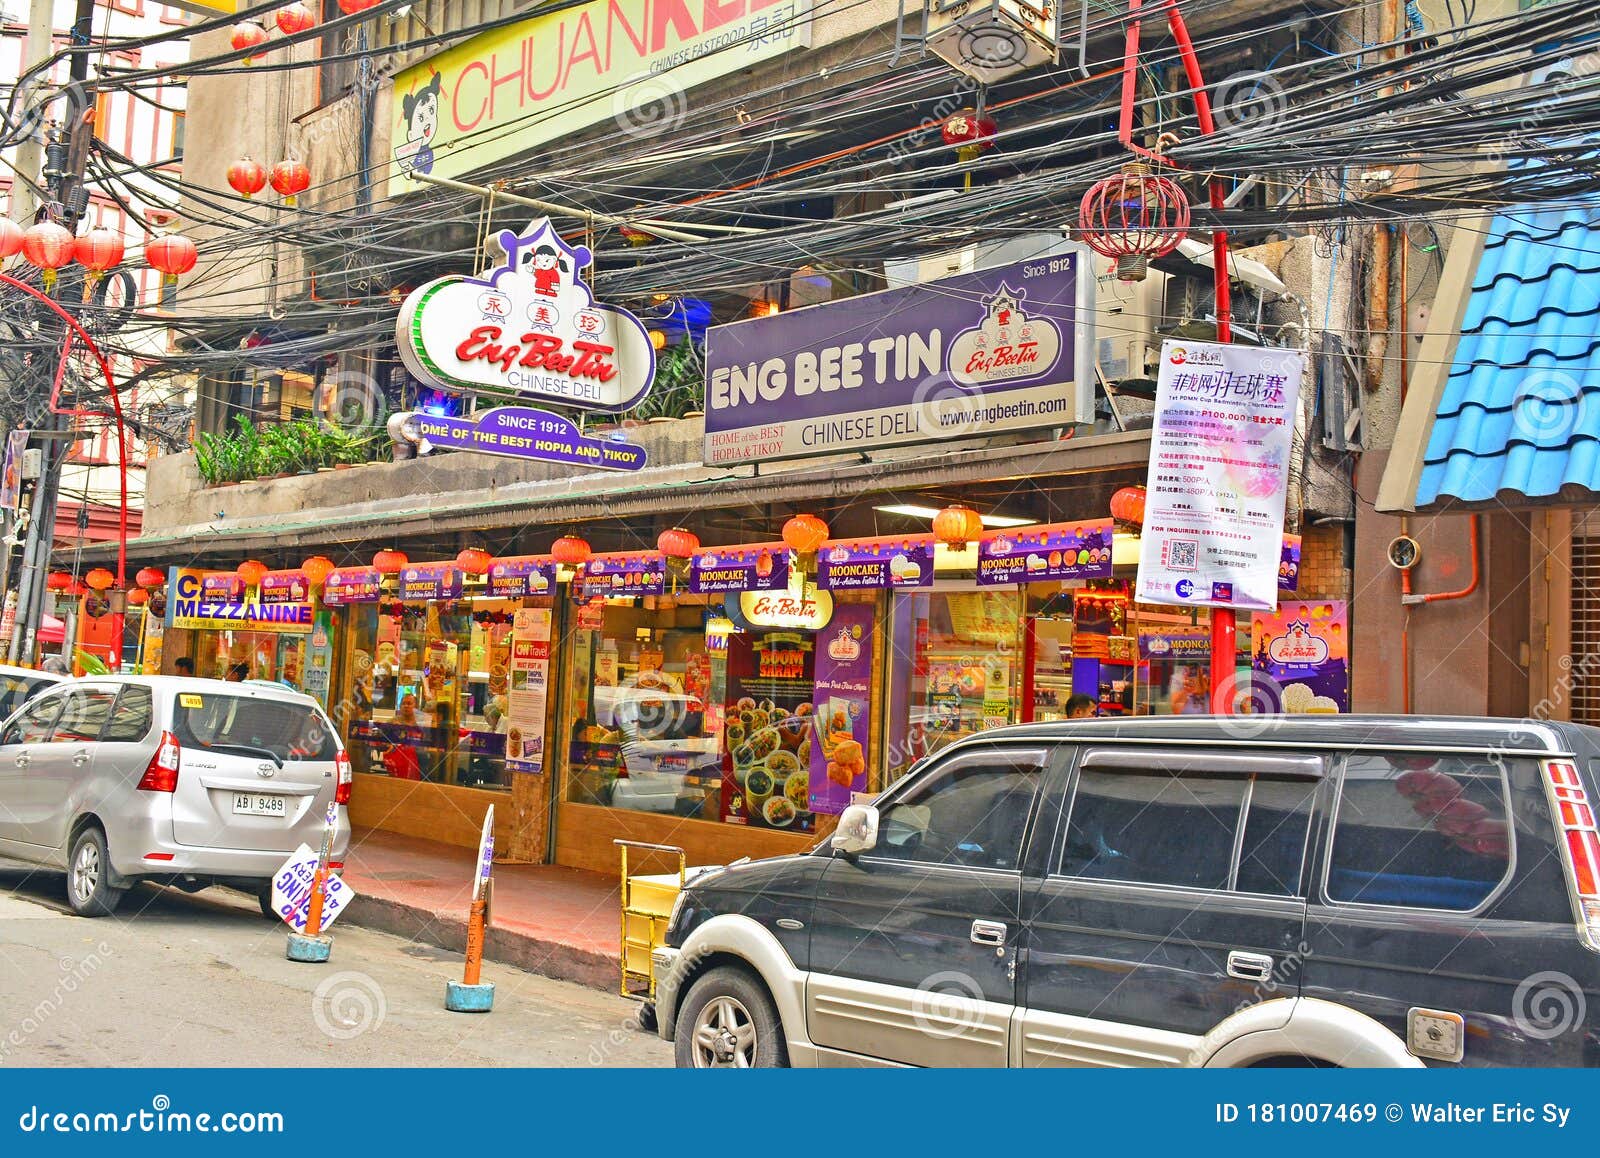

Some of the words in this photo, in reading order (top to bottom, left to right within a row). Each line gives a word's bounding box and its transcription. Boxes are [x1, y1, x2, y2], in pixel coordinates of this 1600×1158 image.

[650, 51, 690, 74] CHINESE
[692, 26, 746, 58] FASTFOOD
[1023, 264, 1047, 279] Since
[1048, 258, 1071, 274] 1912
[710, 356, 788, 410] ENG
[794, 340, 864, 397] BEE
[868, 328, 942, 385] TIN
[507, 371, 569, 395] CHINESE
[573, 381, 601, 400] DELI
[939, 396, 1067, 428] www.engbeetin.com
[497, 414, 537, 431] SINCE
[539, 418, 568, 435] 1912
[801, 416, 876, 448] CHINESE
[880, 410, 920, 438] DELI
[421, 420, 449, 438] OME
[452, 428, 470, 441] OF
[472, 430, 498, 445] THE
[500, 434, 533, 450] BEST
[535, 439, 573, 455] HOPIA
[575, 443, 600, 459] AND
[602, 447, 639, 463] TIKOY
[712, 432, 741, 447] HOME
[759, 425, 786, 439] BEST
[711, 446, 743, 462] HOPIA
[743, 446, 751, 458] &
[751, 440, 785, 456] TIKOY
[829, 564, 880, 577] MOONCAKE
[981, 557, 1026, 569] MOONCAKE
[700, 569, 744, 581] MOONCAKE
[175, 600, 313, 623] MEZZANINE
[753, 597, 777, 618] Eng
[778, 598, 799, 617] Bee
[530, 645, 548, 658] Travel
[1170, 639, 1210, 649] MOONCA
[236, 796, 254, 810] ABI
[259, 798, 284, 811] 9489
[281, 904, 308, 928] NO
